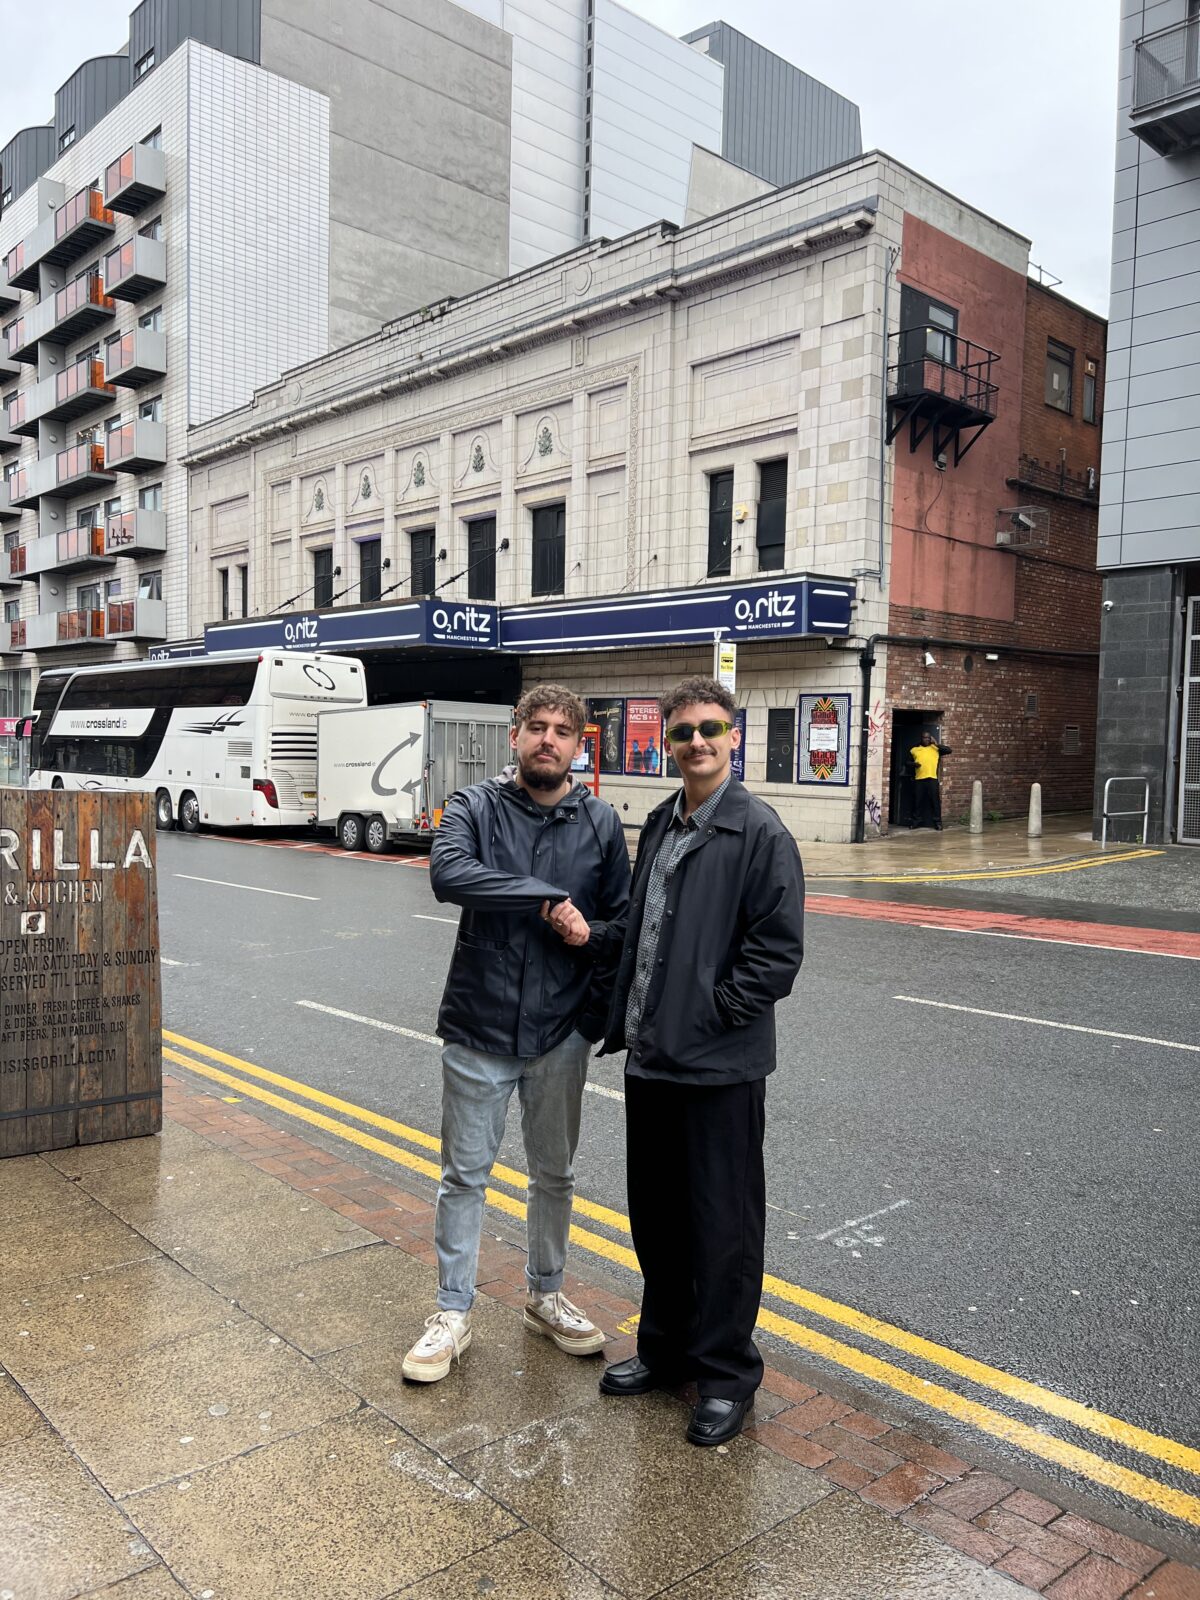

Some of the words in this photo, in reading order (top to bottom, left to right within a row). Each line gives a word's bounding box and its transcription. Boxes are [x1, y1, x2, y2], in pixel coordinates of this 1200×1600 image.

[70, 716, 127, 728] www.crossland.ie
[5, 882, 18, 905] &
[27, 880, 102, 905] KITCHEN
[33, 937, 69, 954] FROM:
[14, 957, 37, 972] 9AM
[43, 953, 98, 970] SATURDAY
[103, 953, 111, 966] &
[116, 950, 156, 966] SUNDAY
[1, 974, 45, 991] SERVED
[75, 971, 98, 986] LATE
[43, 1001, 67, 1013] FRESH
[71, 998, 100, 1010] COFFEE
[103, 998, 110, 1008] &
[112, 995, 140, 1007] SHAKES
[4, 1019, 11, 1029] &
[43, 1014, 67, 1026] SALAD
[71, 1013, 76, 1023] &
[80, 1011, 103, 1022] GRILL
[52, 1027, 66, 1038] GIN
[0, 1049, 115, 1074] ISISGORILLA.COM
